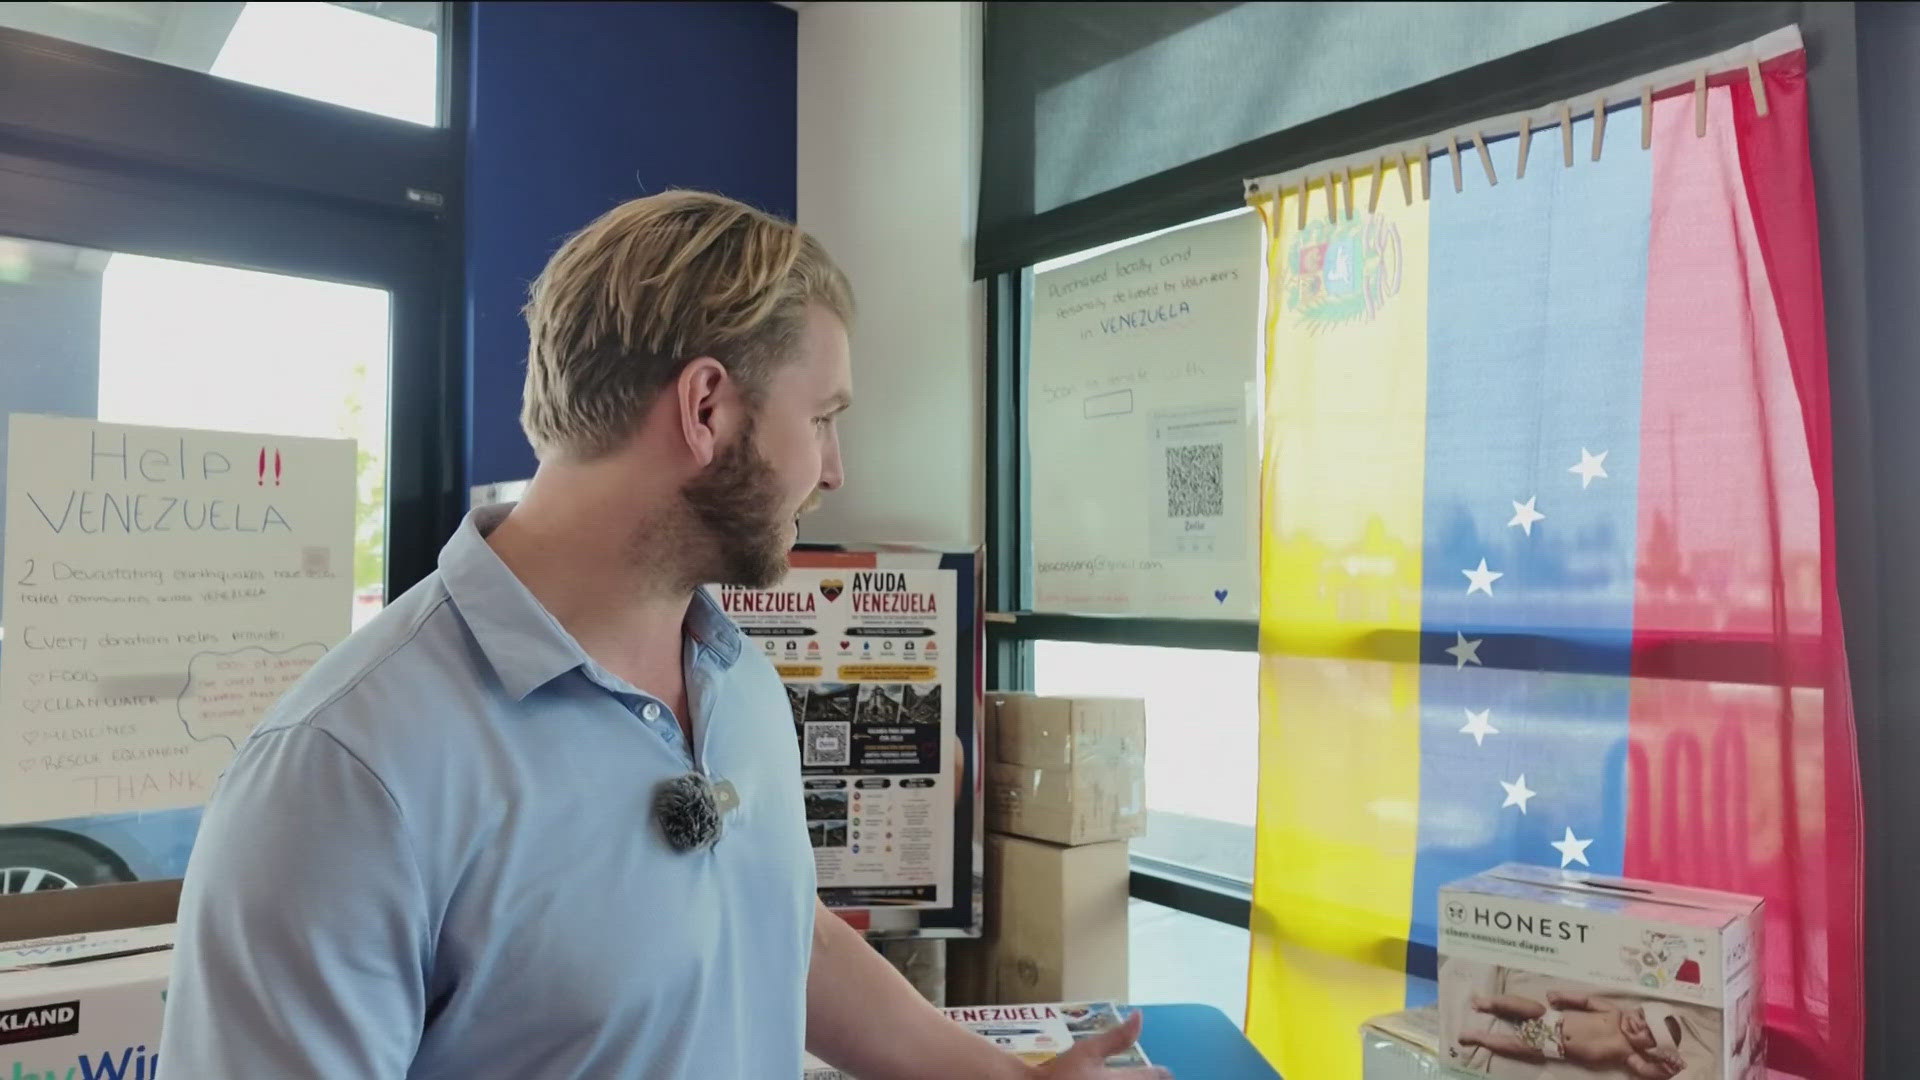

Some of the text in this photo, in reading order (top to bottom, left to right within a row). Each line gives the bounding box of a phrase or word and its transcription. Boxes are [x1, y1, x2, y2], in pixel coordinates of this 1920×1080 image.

[1160, 245, 1192, 266] and
[1100, 301, 1190, 334] VENEZUELA
[91, 430, 231, 482] Help
[27, 490, 292, 534] VENEZUELA
[18, 559, 37, 586] 2
[852, 573, 907, 592] AYUDA
[721, 592, 816, 612] VENEZUELA
[852, 592, 937, 613] VENEZUELA
[24, 626, 87, 650] Every
[98, 632, 169, 648] donation
[49, 670, 98, 683] FOOD
[44, 697, 99, 712] CLEAN
[45, 753, 101, 770] RESCUE
[72, 771, 206, 808] THANK
[1474, 907, 1590, 943] HONEST
[944, 1006, 1057, 1021] ENEZUELA
